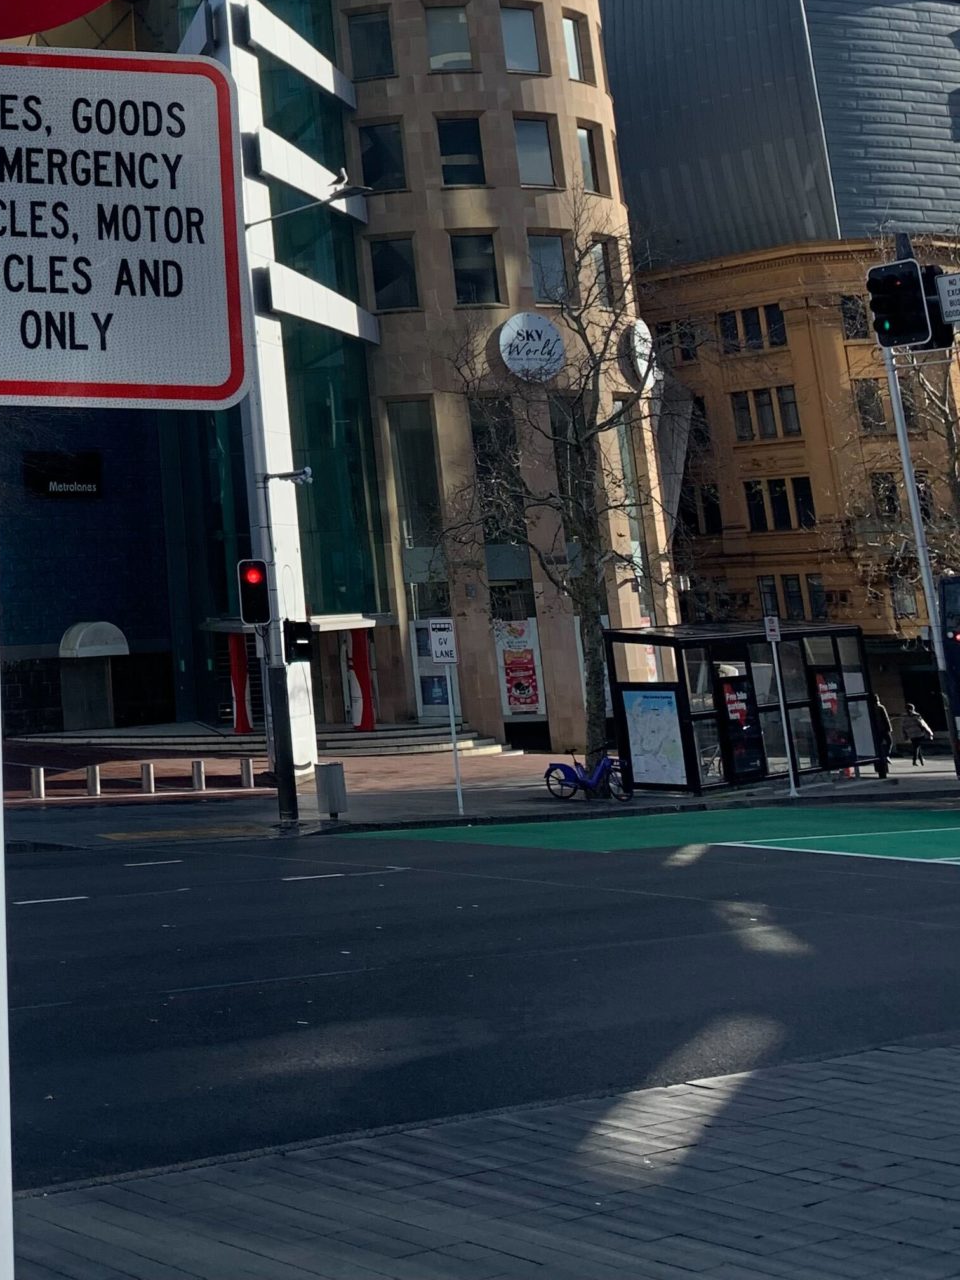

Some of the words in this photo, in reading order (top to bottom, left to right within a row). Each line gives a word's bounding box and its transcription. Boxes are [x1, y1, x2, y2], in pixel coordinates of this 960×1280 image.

[71, 97, 186, 139] GOODS
[96, 202, 206, 245] MOTOR
[113, 258, 184, 298] AND
[19, 309, 114, 352] ONLY
[516, 328, 544, 342] SKY
[507, 338, 560, 358] World
[49, 481, 97, 492] Metrolanes
[438, 637, 448, 646] GV
[435, 650, 455, 658] LANE
